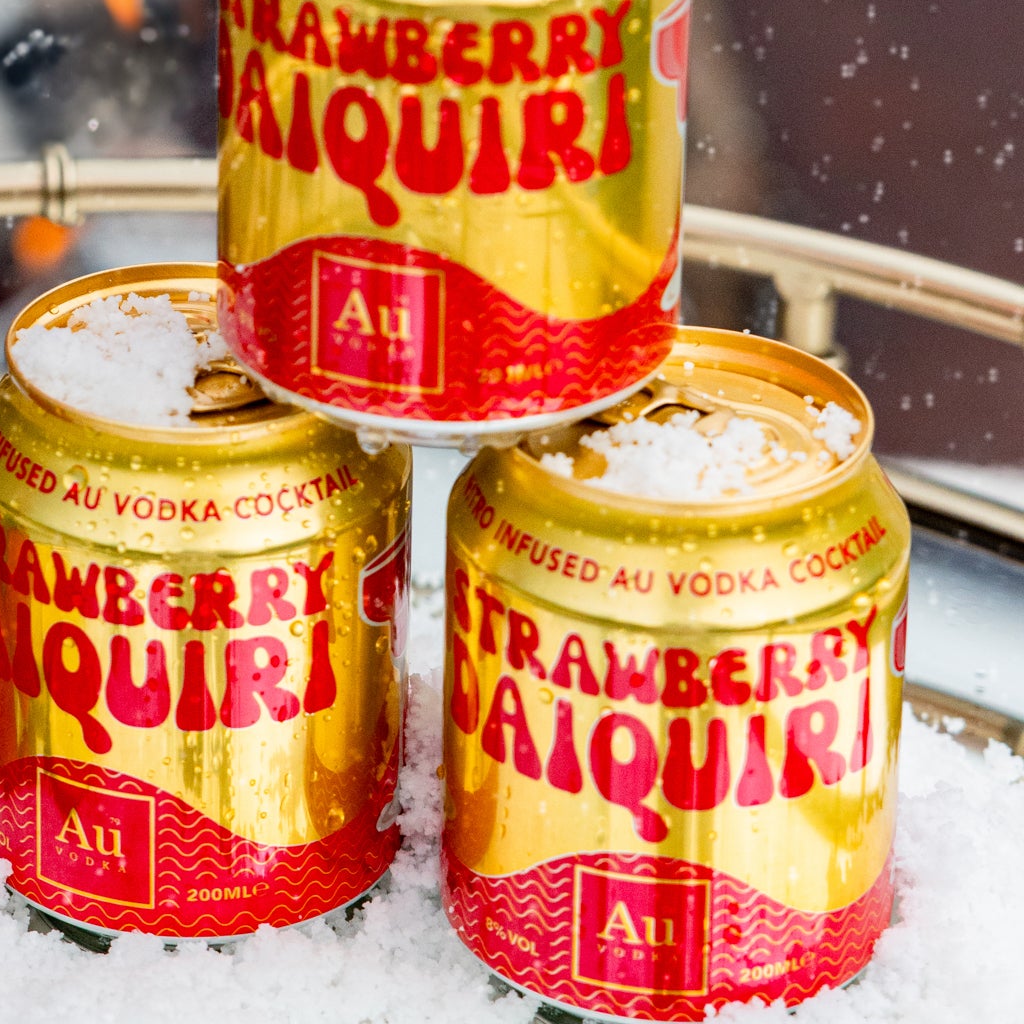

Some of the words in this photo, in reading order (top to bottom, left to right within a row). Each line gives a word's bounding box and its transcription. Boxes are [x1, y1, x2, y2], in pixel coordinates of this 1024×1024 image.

[333, 286, 413, 342] Au
[62, 482, 103, 510] AU
[114, 491, 222, 523] VODKA
[233, 465, 359, 519] COCKTAIL
[494, 518, 600, 582] INFUSED
[610, 566, 655, 594] AU
[667, 568, 780, 597] VODKA
[788, 516, 887, 583] COCKTAIL
[453, 568, 877, 708] STRAWBERRY
[450, 631, 874, 844] DAIQUIRI
[54, 807, 125, 858] Au
[55, 845, 127, 874] VODKA
[596, 900, 676, 948] Au
